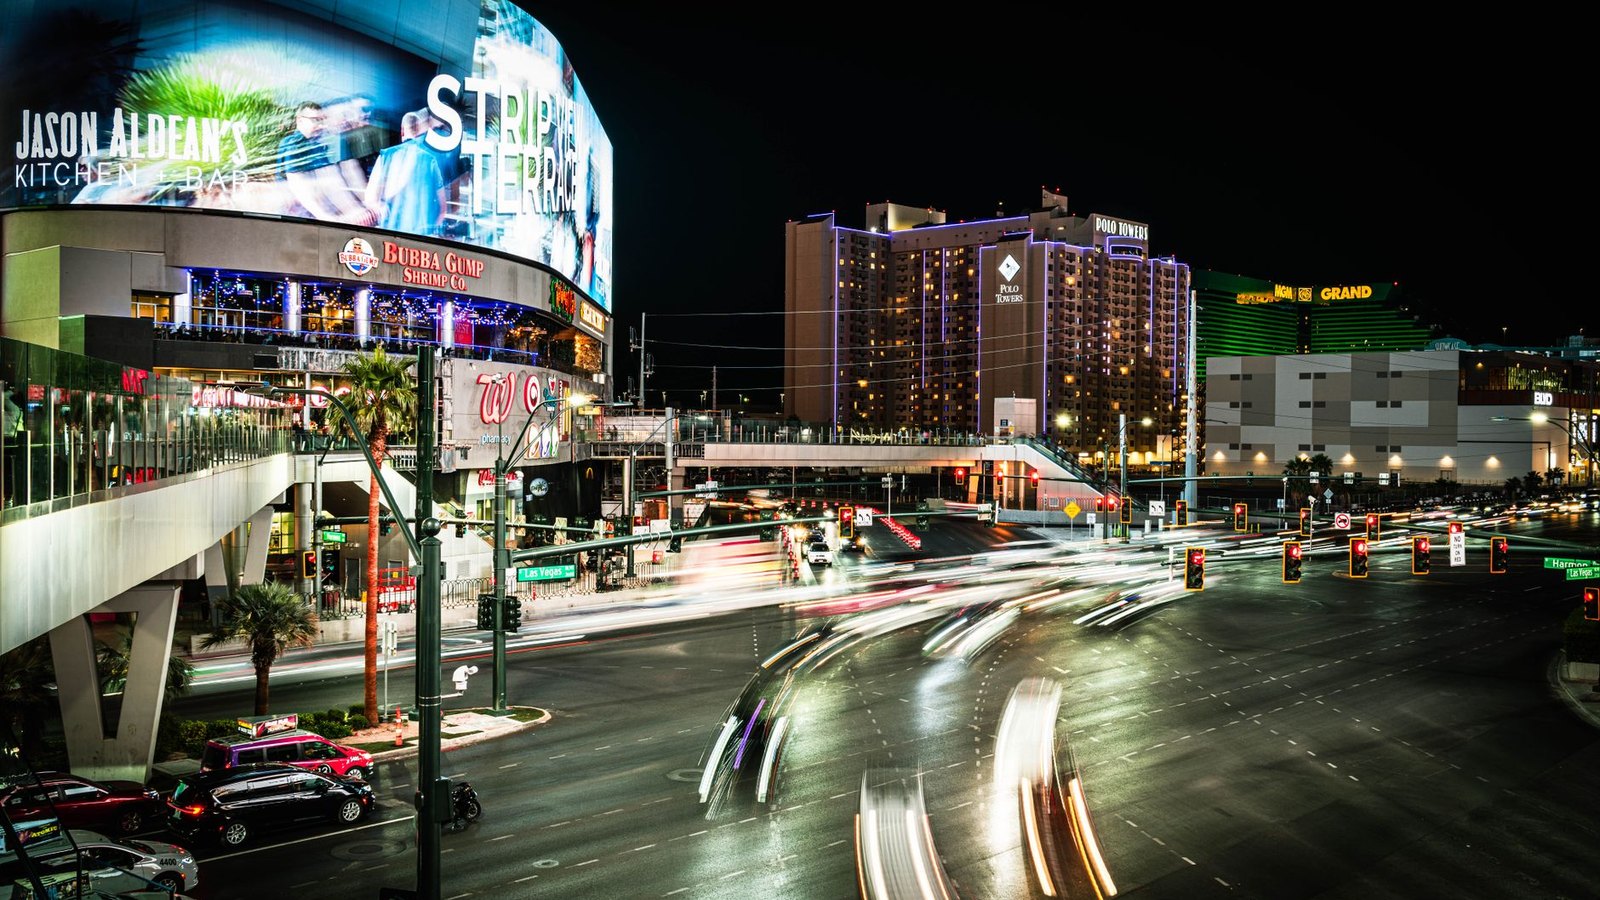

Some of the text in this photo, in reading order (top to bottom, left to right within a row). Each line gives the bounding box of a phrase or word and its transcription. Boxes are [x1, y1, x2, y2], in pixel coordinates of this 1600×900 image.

[425, 73, 552, 152] STRIP
[16, 107, 248, 165] JASON ALDEAN'S
[15, 162, 137, 188] KITCHEN
[186, 165, 249, 194] BAR
[461, 139, 577, 216] TERRACE
[1096, 217, 1148, 241] POLO TOWERS
[383, 241, 484, 278] BUBBA GUMP
[403, 267, 468, 291] SHRIMP CO.
[1000, 284, 1019, 294] POLO
[995, 294, 1024, 304] TOWERS
[1274, 283, 1293, 300] MGM
[1320, 286, 1372, 301] GRAND
[480, 433, 511, 446] pharmacy
[525, 566, 562, 578] Las Vegas
[1570, 569, 1579, 577] Las
[1579, 567, 1593, 579] Vegas
[159, 858, 177, 866] 4400
